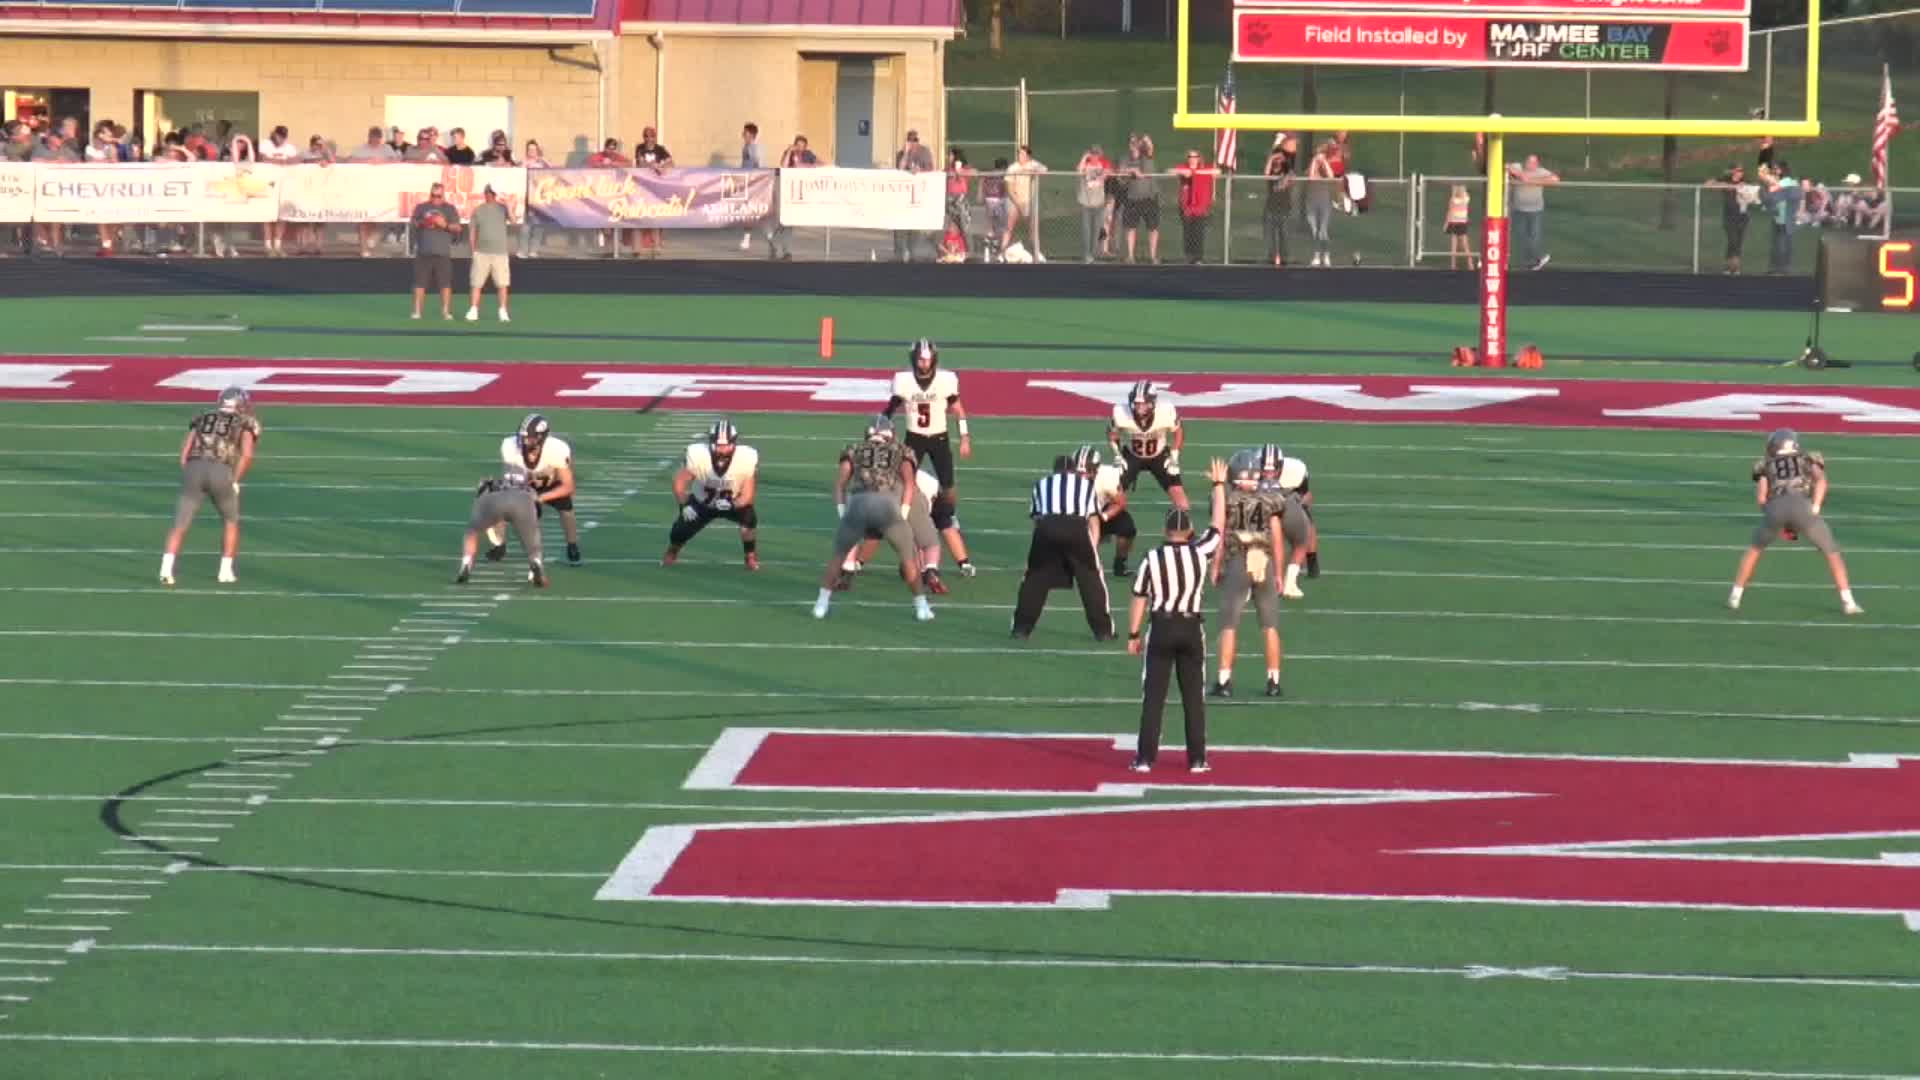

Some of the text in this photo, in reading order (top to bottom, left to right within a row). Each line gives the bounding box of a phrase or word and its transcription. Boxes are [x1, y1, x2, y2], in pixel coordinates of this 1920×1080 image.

[1304, 25, 1468, 49] Field Installed by
[1607, 26, 1654, 43] BAY
[1559, 44, 1650, 60] CENTER
[42, 181, 192, 198] CHEVROLET
[1880, 243, 1913, 306] 5
[202, 413, 233, 436] 83
[917, 403, 931, 428] 5
[1131, 438, 1158, 457] 20
[1775, 456, 1800, 479] 81
[1236, 500, 1265, 531] 14
